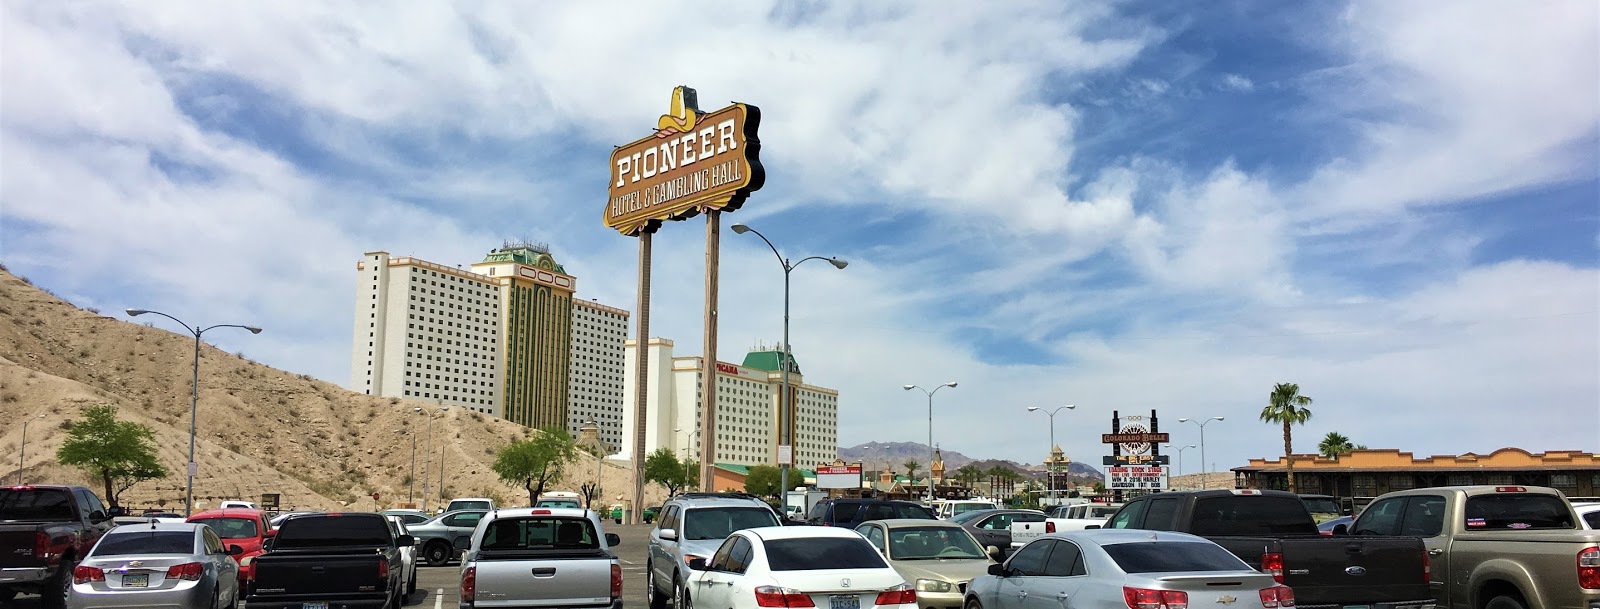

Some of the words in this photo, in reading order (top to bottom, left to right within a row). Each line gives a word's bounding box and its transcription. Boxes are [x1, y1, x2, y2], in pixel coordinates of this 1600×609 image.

[616, 118, 737, 188] PIONEER
[611, 189, 642, 218] HOTEL
[644, 188, 651, 208] &
[653, 169, 709, 205] GAMBLING
[711, 159, 742, 188] HALL
